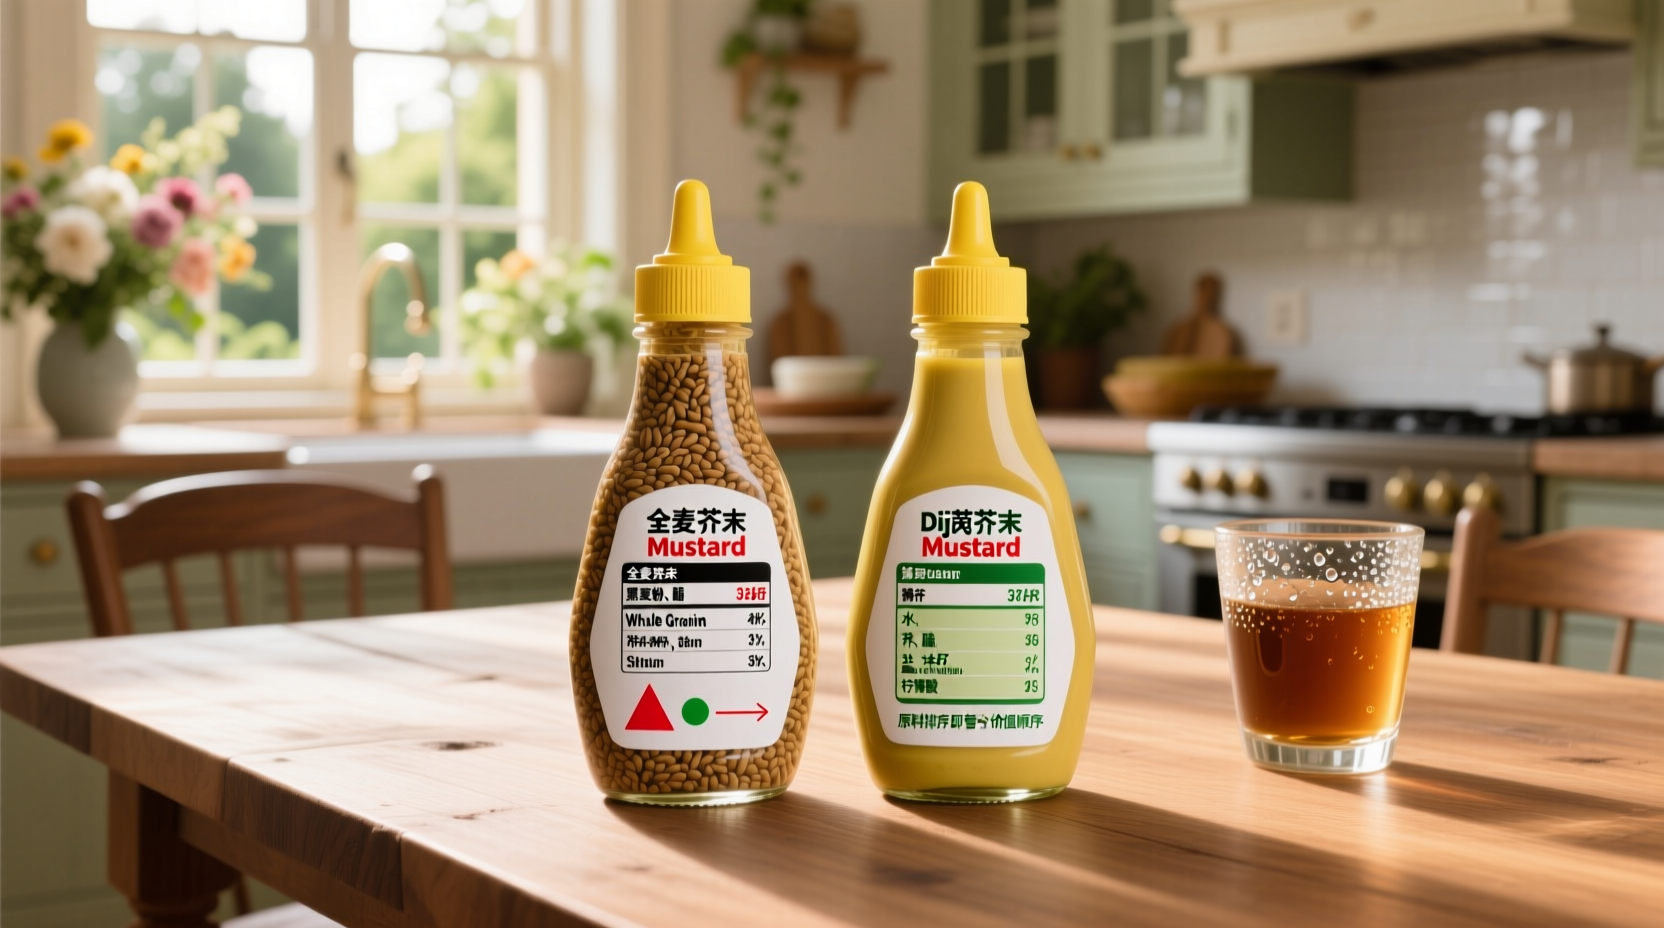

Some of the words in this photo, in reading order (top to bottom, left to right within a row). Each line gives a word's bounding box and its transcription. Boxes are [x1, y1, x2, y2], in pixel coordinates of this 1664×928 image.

[647, 507, 746, 534] 全麦芥末
[647, 535, 746, 557] Mustard
[922, 535, 1021, 557] Mustard
